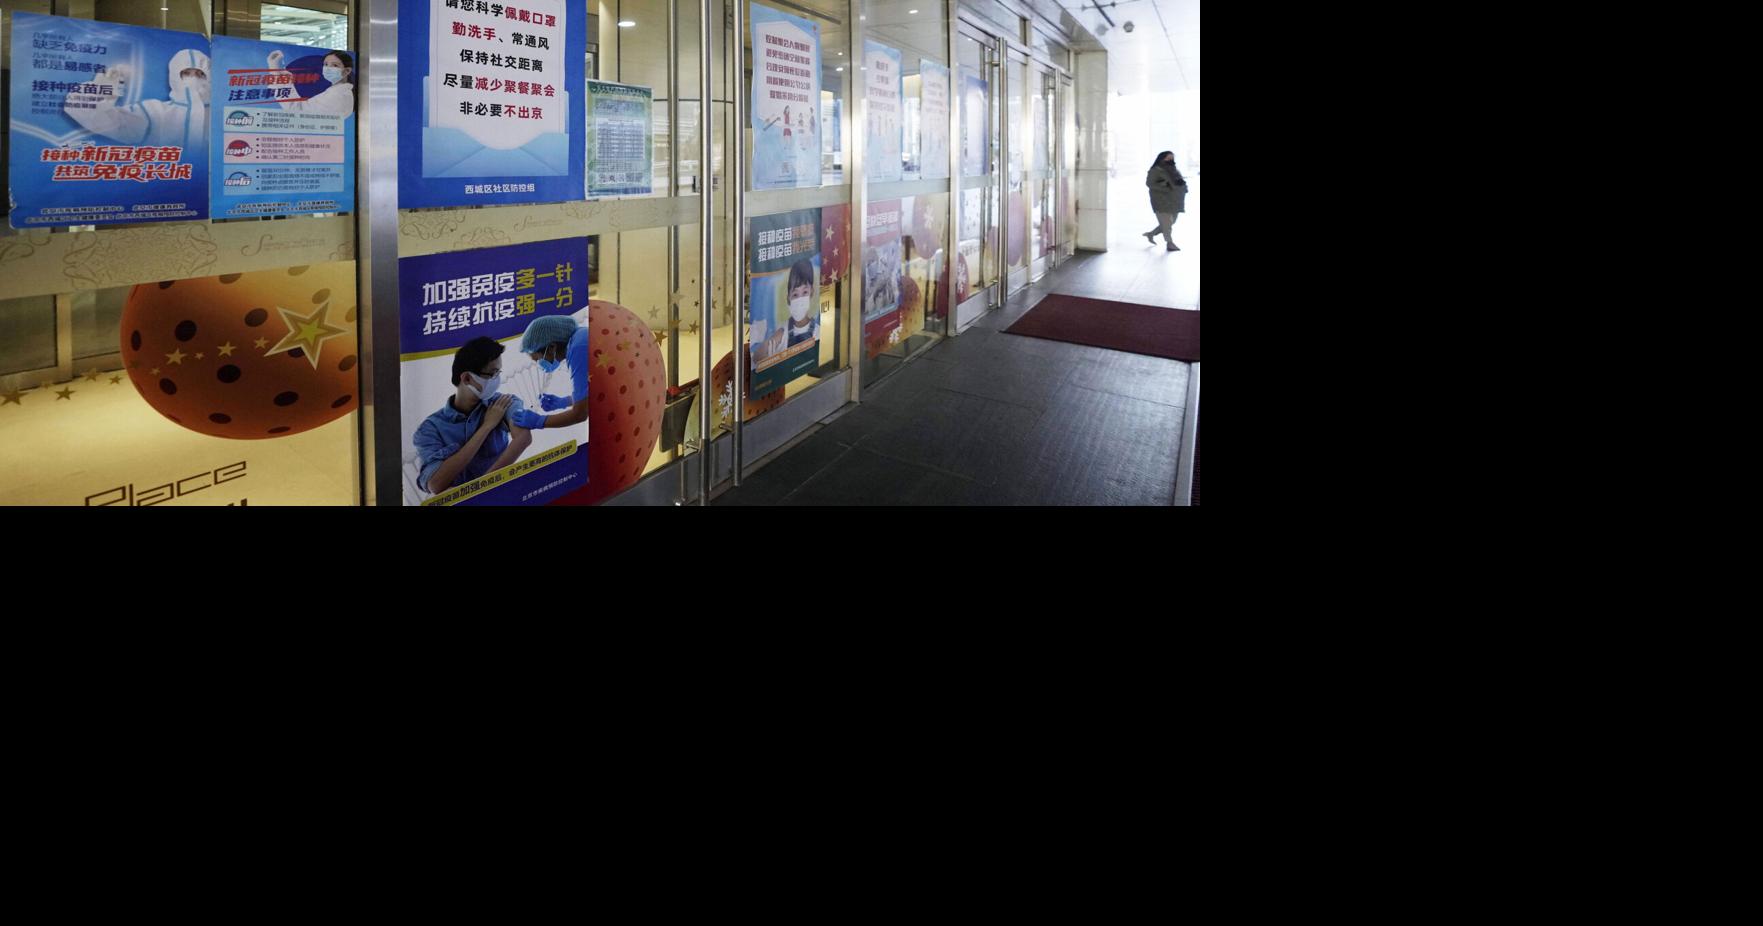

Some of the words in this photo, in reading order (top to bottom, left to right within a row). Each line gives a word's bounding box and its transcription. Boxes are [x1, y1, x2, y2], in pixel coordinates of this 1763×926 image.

[445, 0, 556, 28] 请您科学佩戴口罩
[452, 21, 550, 50] 勤洗手、常通风
[32, 39, 107, 55] 缺乏免疫力
[33, 59, 106, 73] 都是易感者
[460, 48, 543, 72] 保持社交距离
[32, 80, 113, 95] 接种疫苗后
[229, 72, 321, 86] 新冠疫苗接种
[443, 74, 556, 98] 尽量减少聚餐聚会
[228, 88, 291, 101] 注意事项
[460, 101, 543, 120] 非必要不出京
[41, 146, 182, 163] 接种新冠疫苗
[53, 163, 192, 182] 共筑免疫长城
[464, 184, 536, 194] 西城区社区防控组
[422, 262, 573, 307] 加强免疫多一针
[423, 287, 574, 336] 持续抗疫强一分
[85, 460, 247, 506] Place
